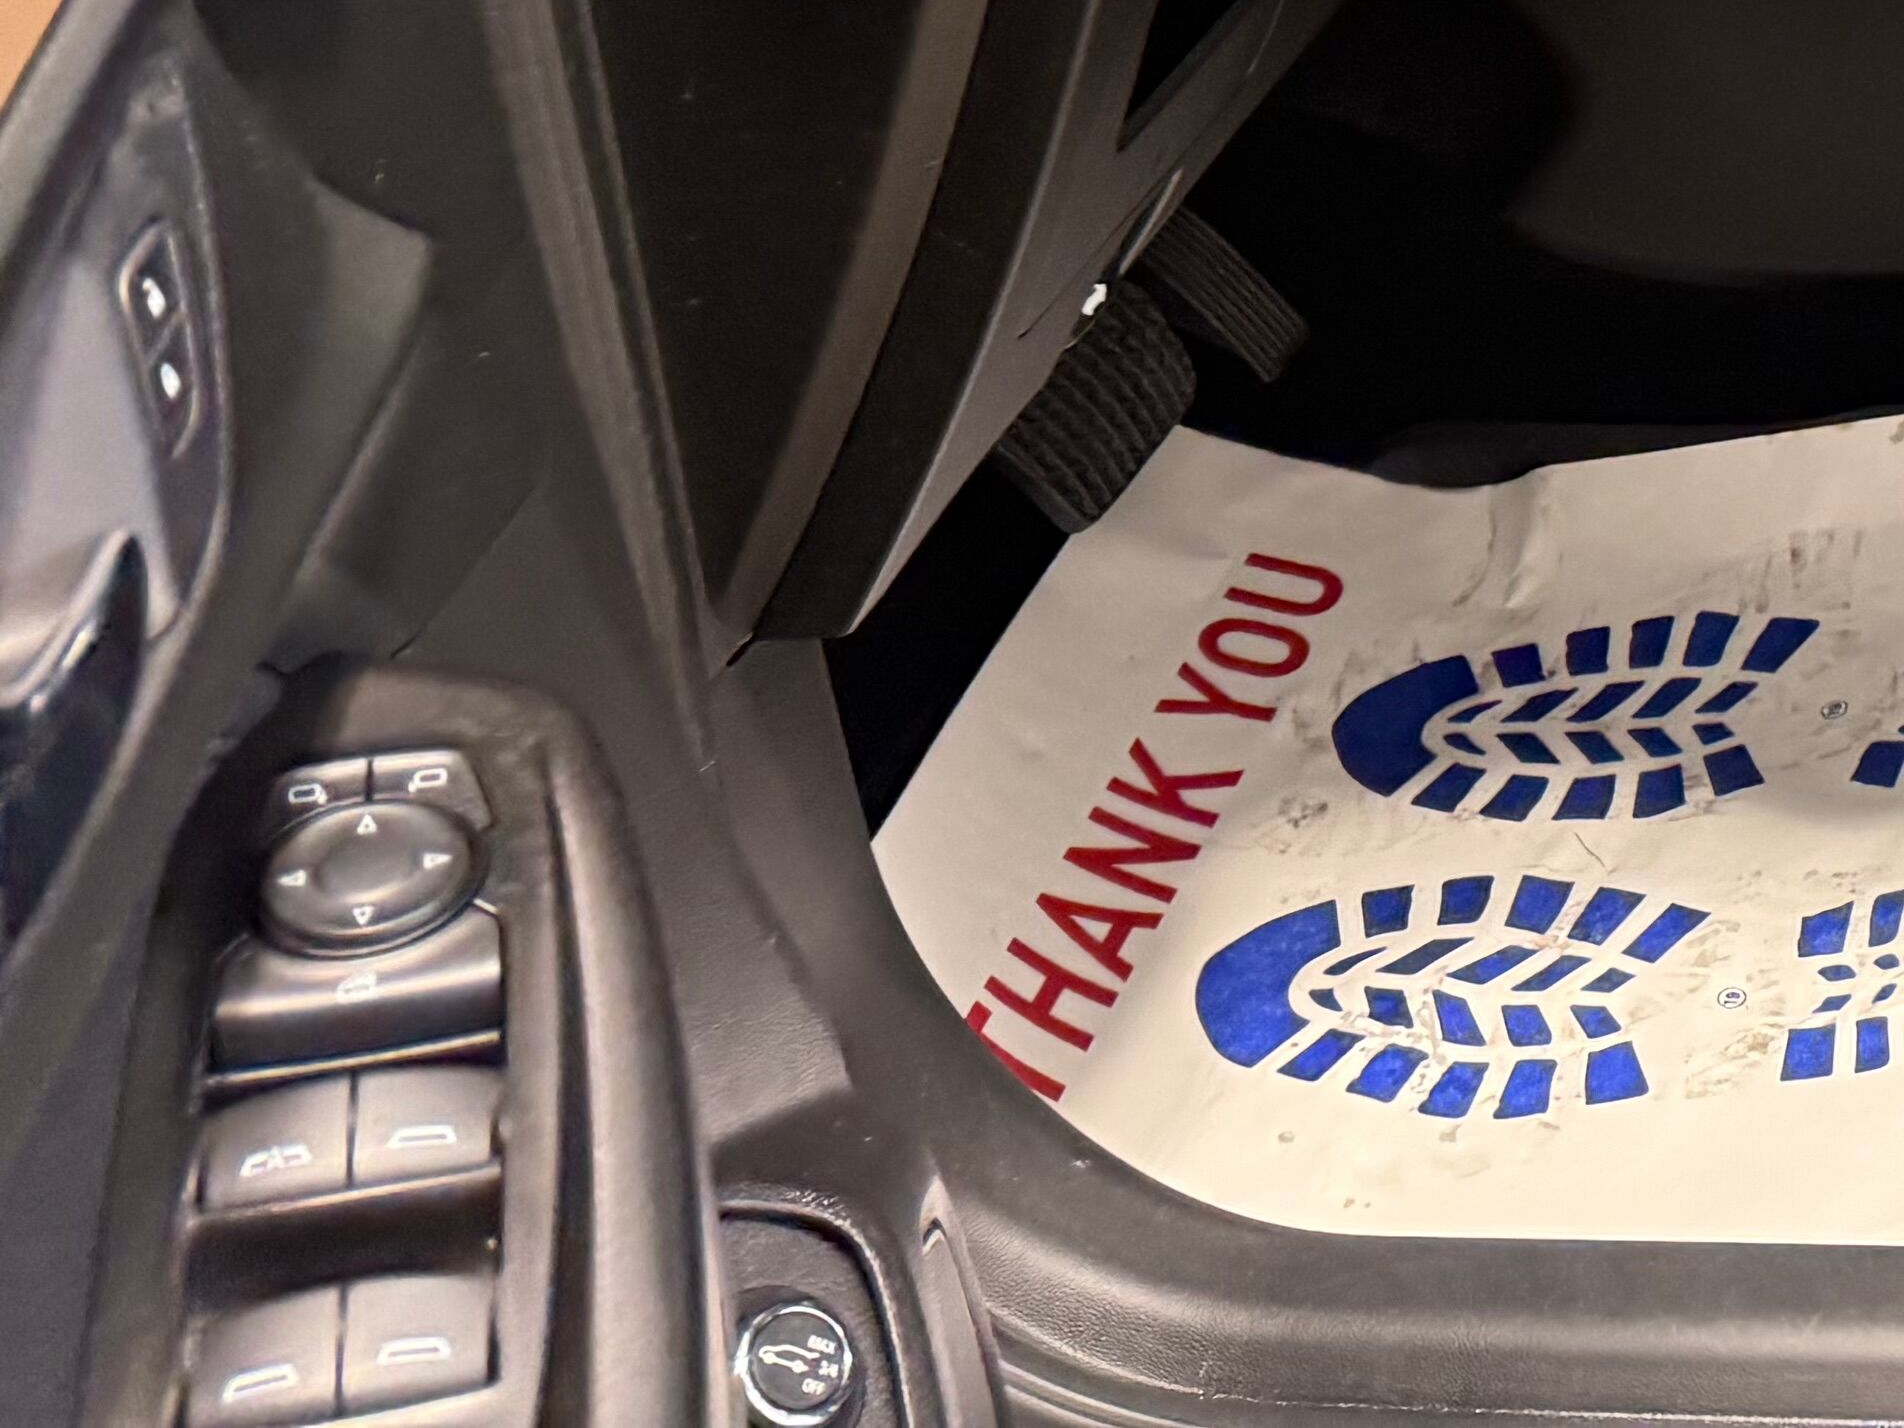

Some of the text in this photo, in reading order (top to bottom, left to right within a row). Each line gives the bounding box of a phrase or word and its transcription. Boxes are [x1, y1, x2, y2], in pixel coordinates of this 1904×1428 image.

[966, 553, 1344, 1101] THANK YOU
[802, 1378, 826, 1395] OFF
